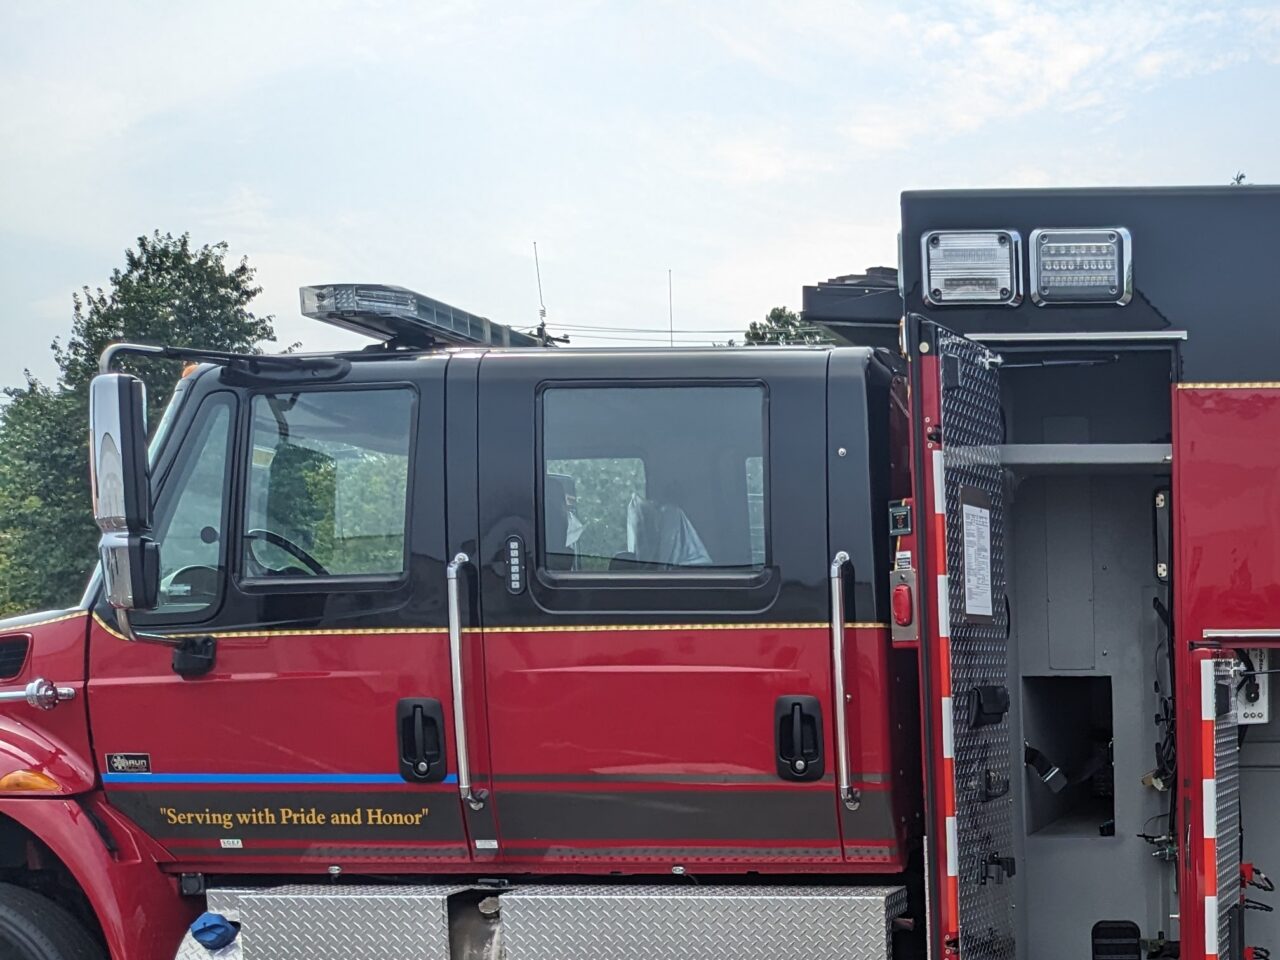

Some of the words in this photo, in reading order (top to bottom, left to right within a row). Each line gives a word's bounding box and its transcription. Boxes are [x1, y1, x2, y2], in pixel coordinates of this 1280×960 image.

[159, 807, 233, 829] "Serving
[235, 808, 276, 825] with
[279, 807, 326, 825] Pride
[330, 807, 362, 825] and
[366, 807, 429, 825] Honor"
